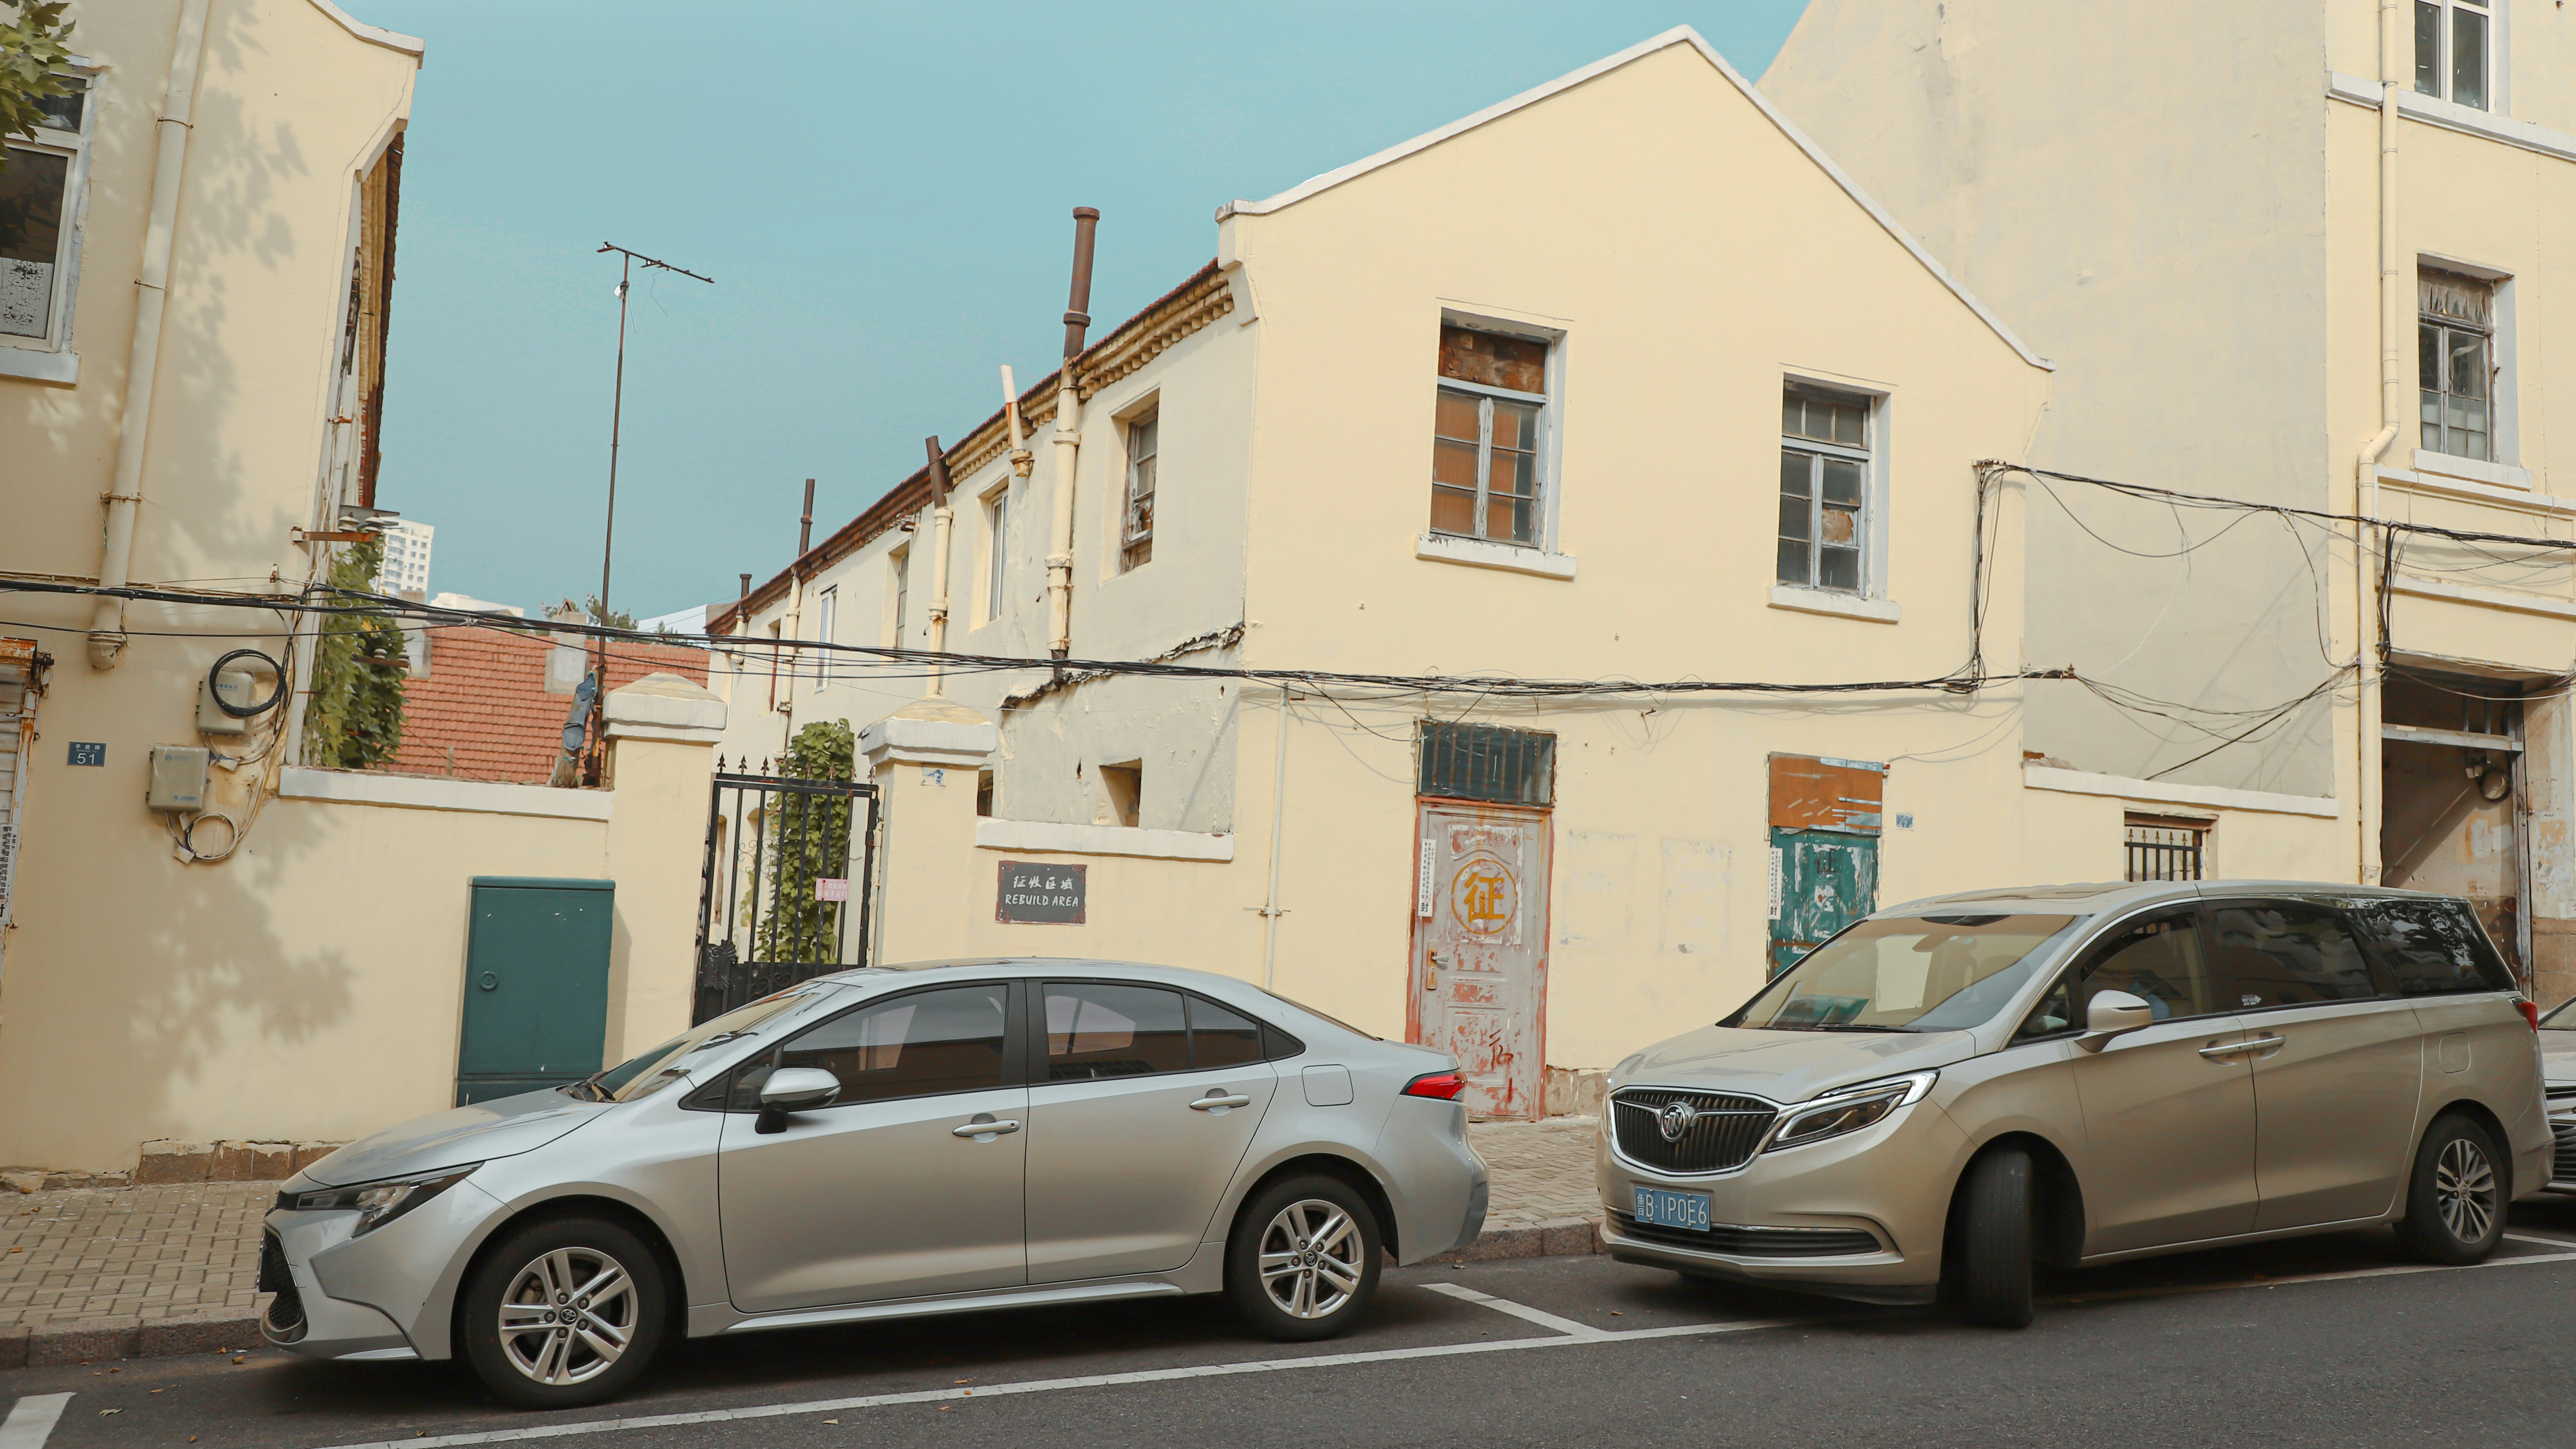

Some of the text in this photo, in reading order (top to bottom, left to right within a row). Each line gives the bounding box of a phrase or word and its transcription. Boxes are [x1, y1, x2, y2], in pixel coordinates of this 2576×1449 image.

[77, 753, 95, 765] 51
[1013, 875, 1073, 890] 征收区域
[1005, 894, 1079, 907] REBUILD AREA
[1463, 872, 1506, 923] 征
[1420, 902, 1429, 912] 封
